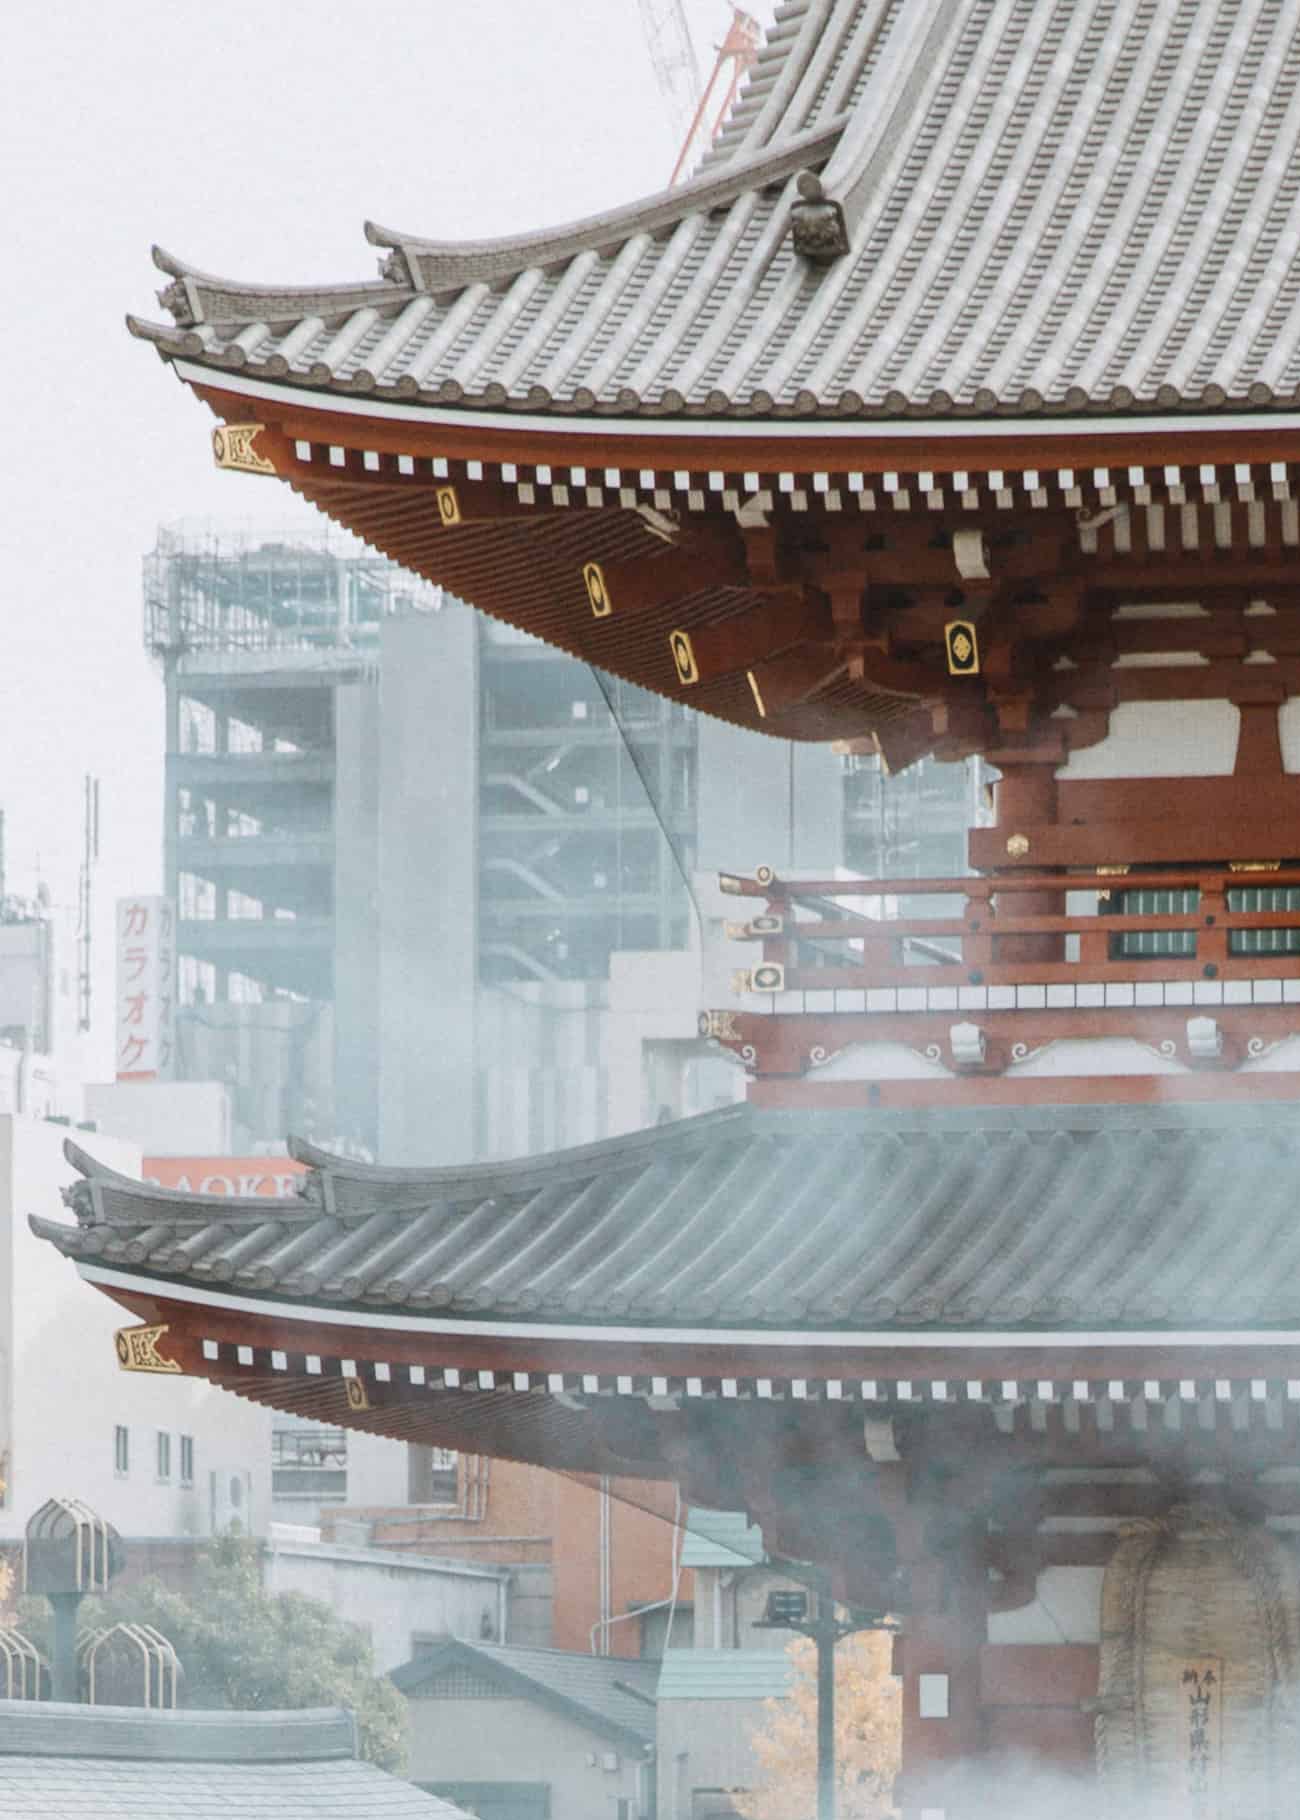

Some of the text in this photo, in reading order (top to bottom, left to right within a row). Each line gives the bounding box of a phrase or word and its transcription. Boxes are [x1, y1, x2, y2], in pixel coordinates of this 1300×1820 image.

[121, 904, 149, 1070] カラオケ
[143, 1174, 301, 1198] AOKE
